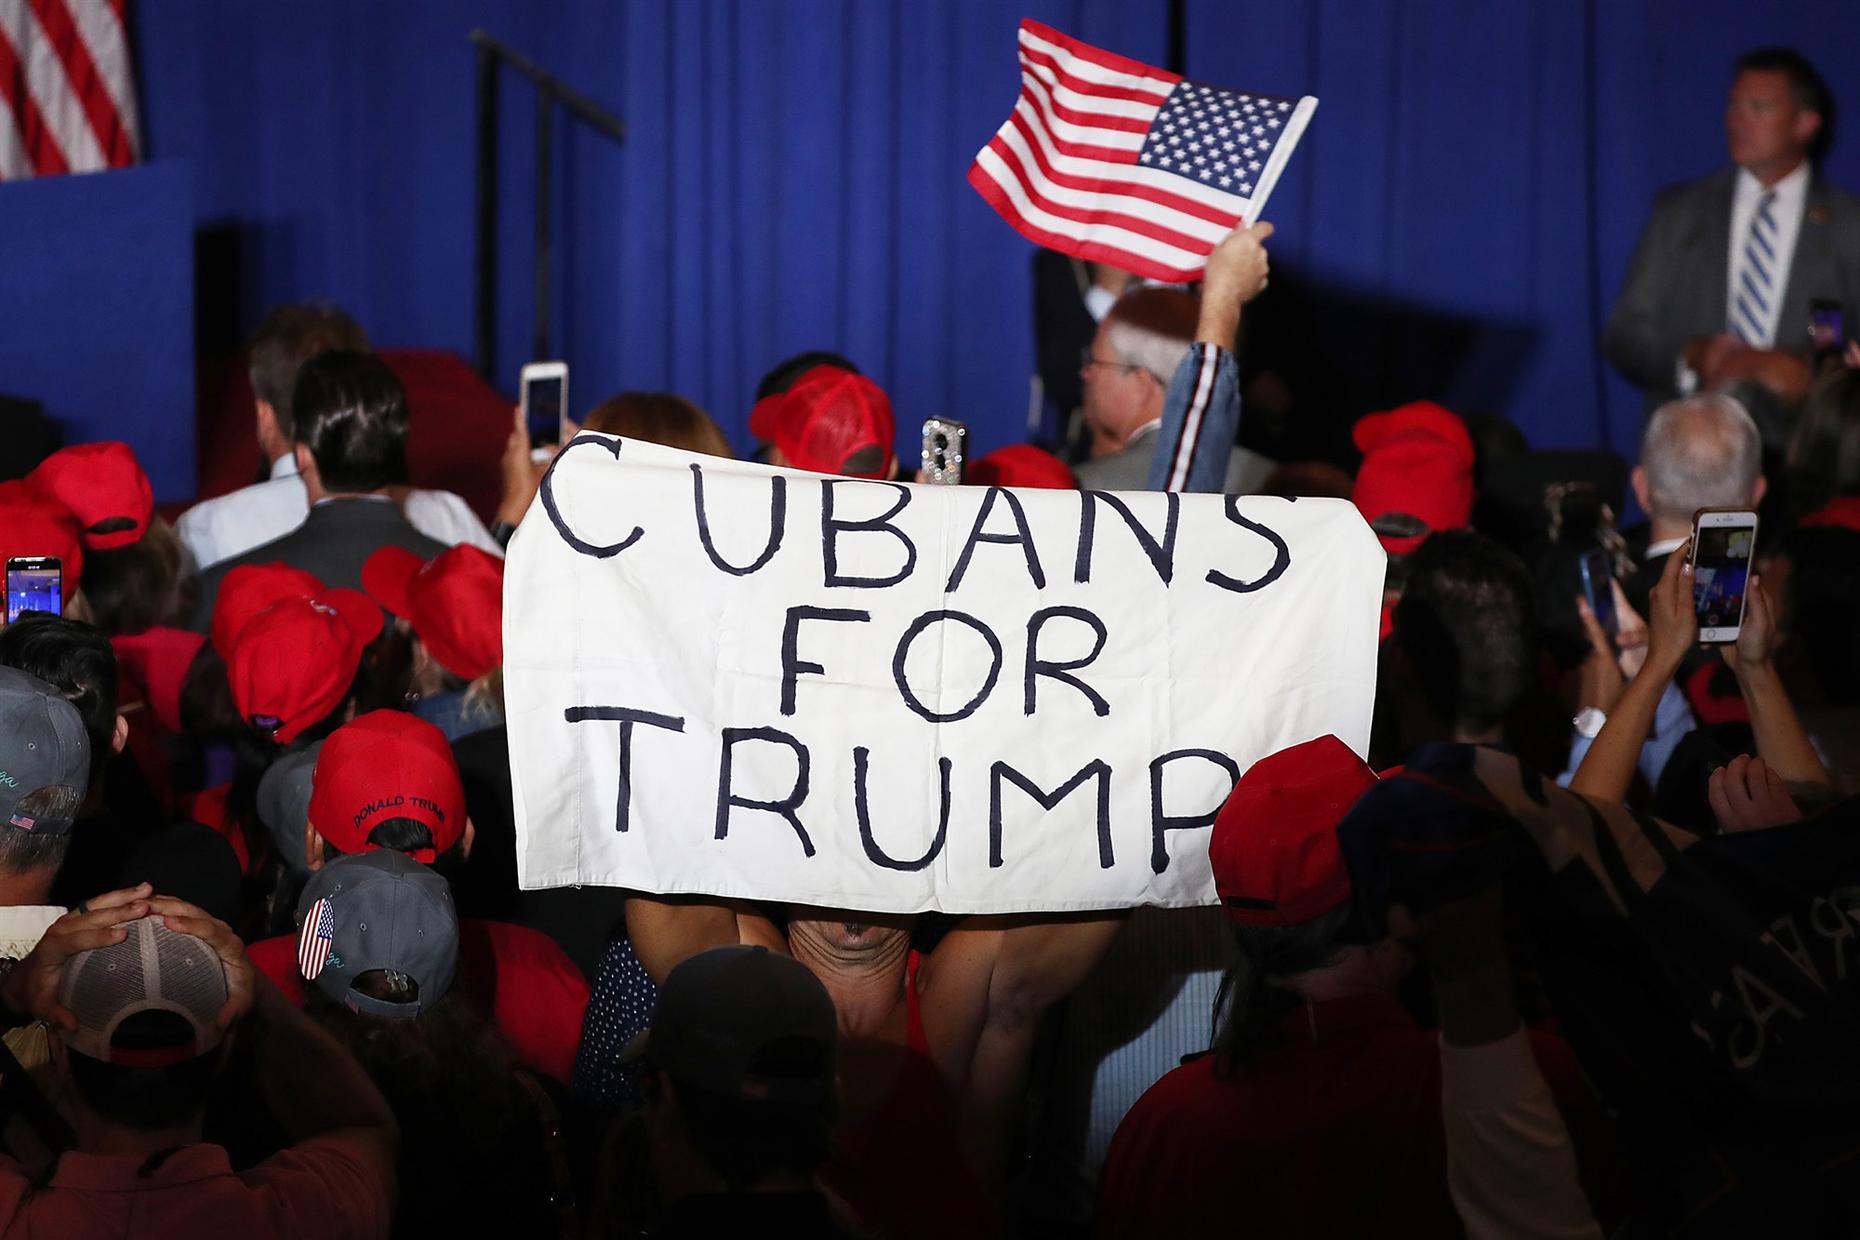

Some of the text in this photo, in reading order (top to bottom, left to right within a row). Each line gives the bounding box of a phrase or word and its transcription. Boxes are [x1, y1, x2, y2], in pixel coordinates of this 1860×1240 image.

[540, 434, 1298, 594] CUBANS
[780, 605, 1111, 724] FOR
[353, 795, 405, 829] DONALD
[565, 706, 1241, 876] TRUMP
